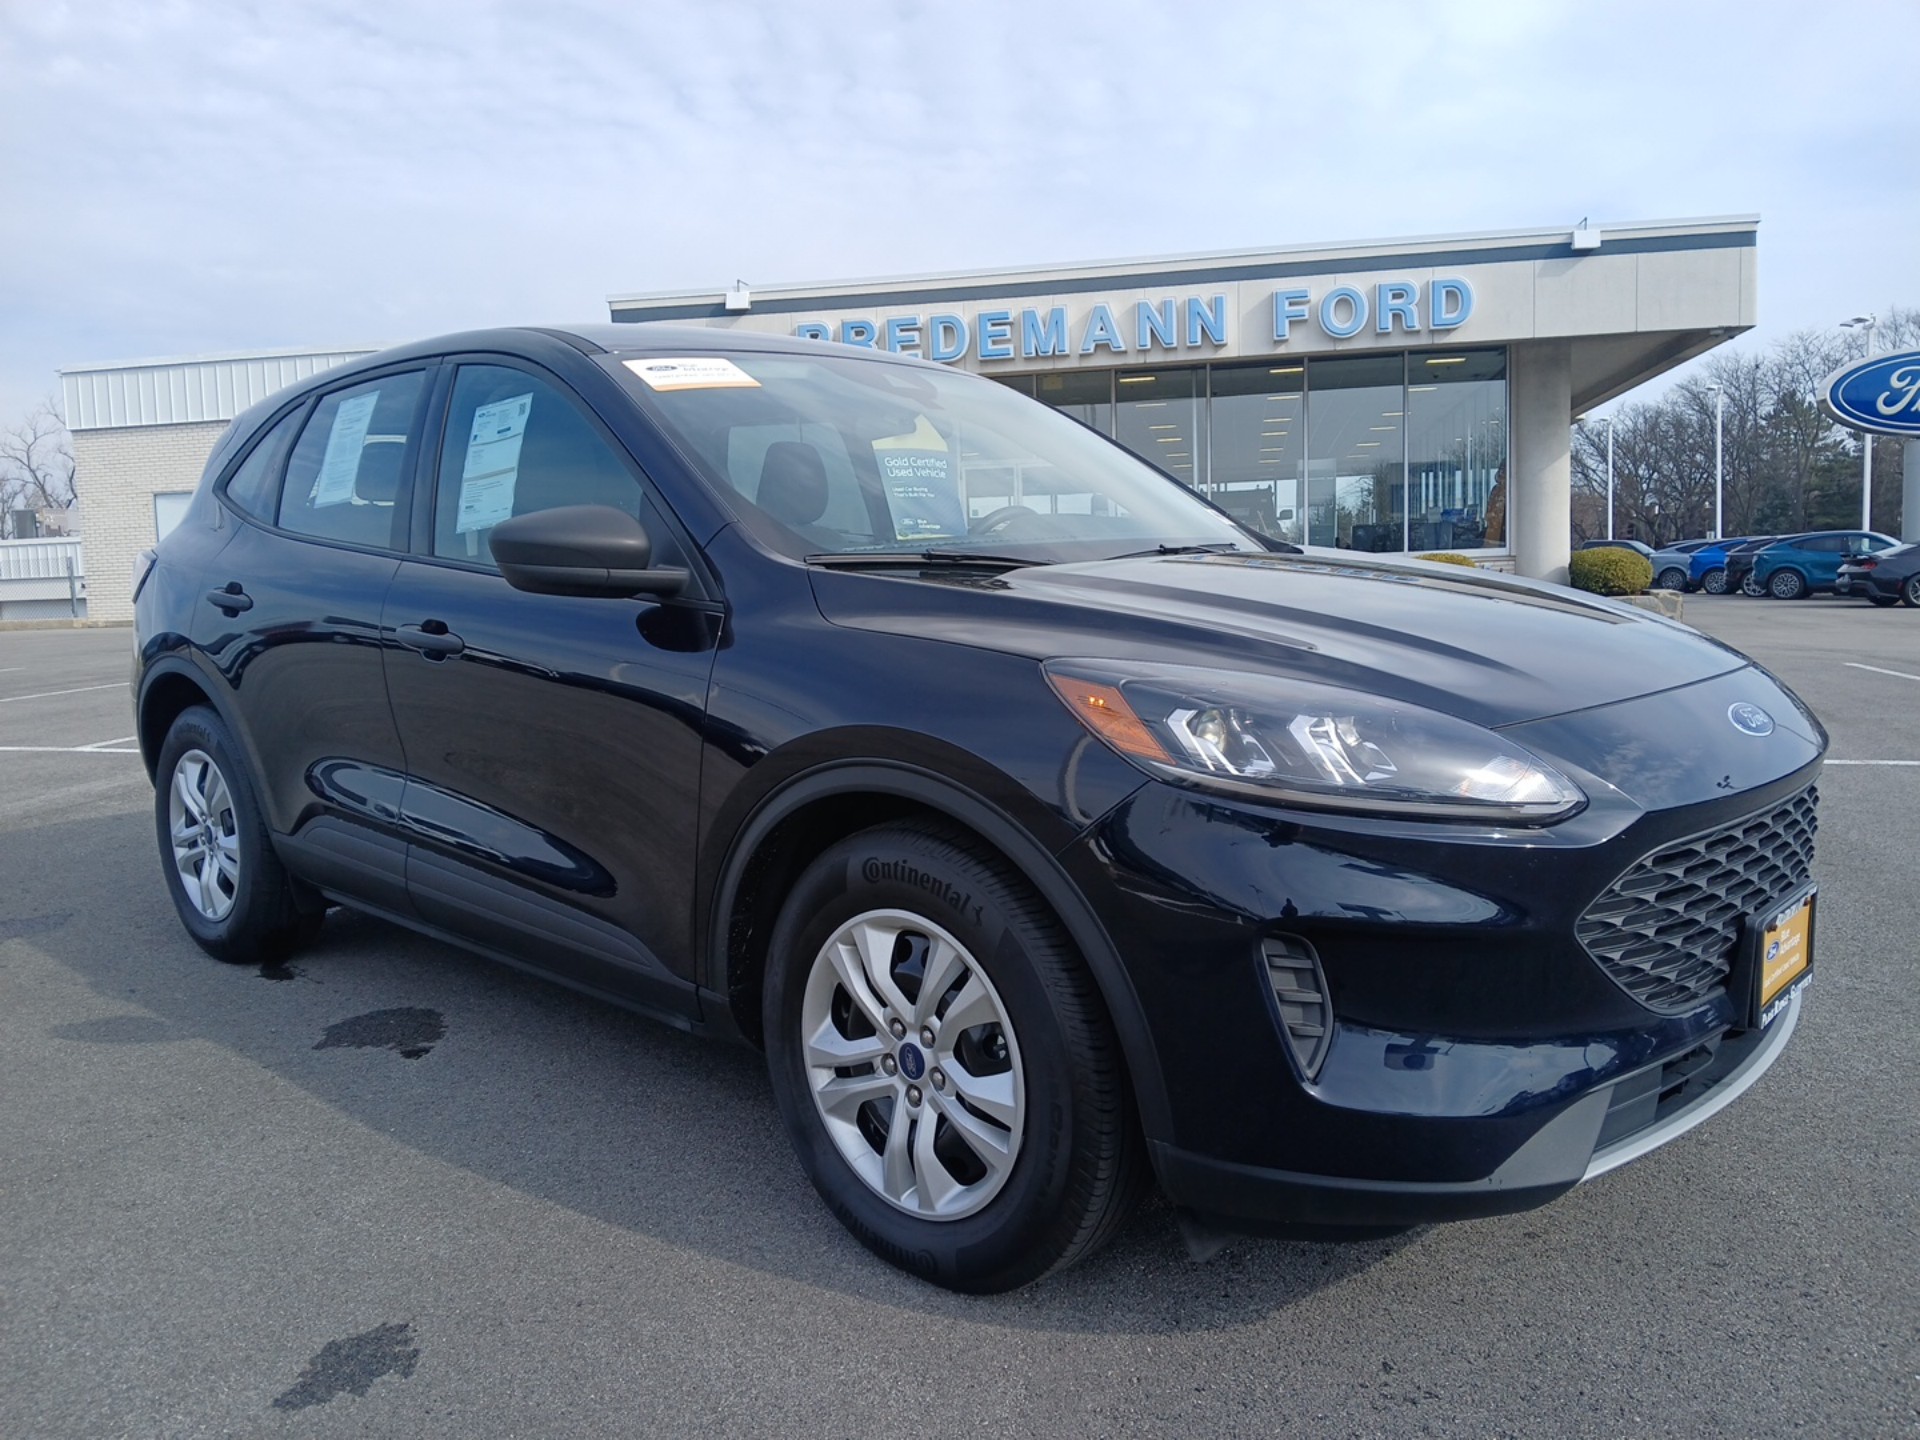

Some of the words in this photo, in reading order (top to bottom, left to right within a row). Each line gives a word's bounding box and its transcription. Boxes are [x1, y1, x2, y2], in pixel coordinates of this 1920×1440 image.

[1273, 276, 1476, 341] FORD
[885, 456, 909, 467] Gold
[910, 456, 947, 468] Certified
[887, 467, 913, 477] Used
[914, 467, 946, 479] Vehicle
[862, 857, 972, 914] Continental
